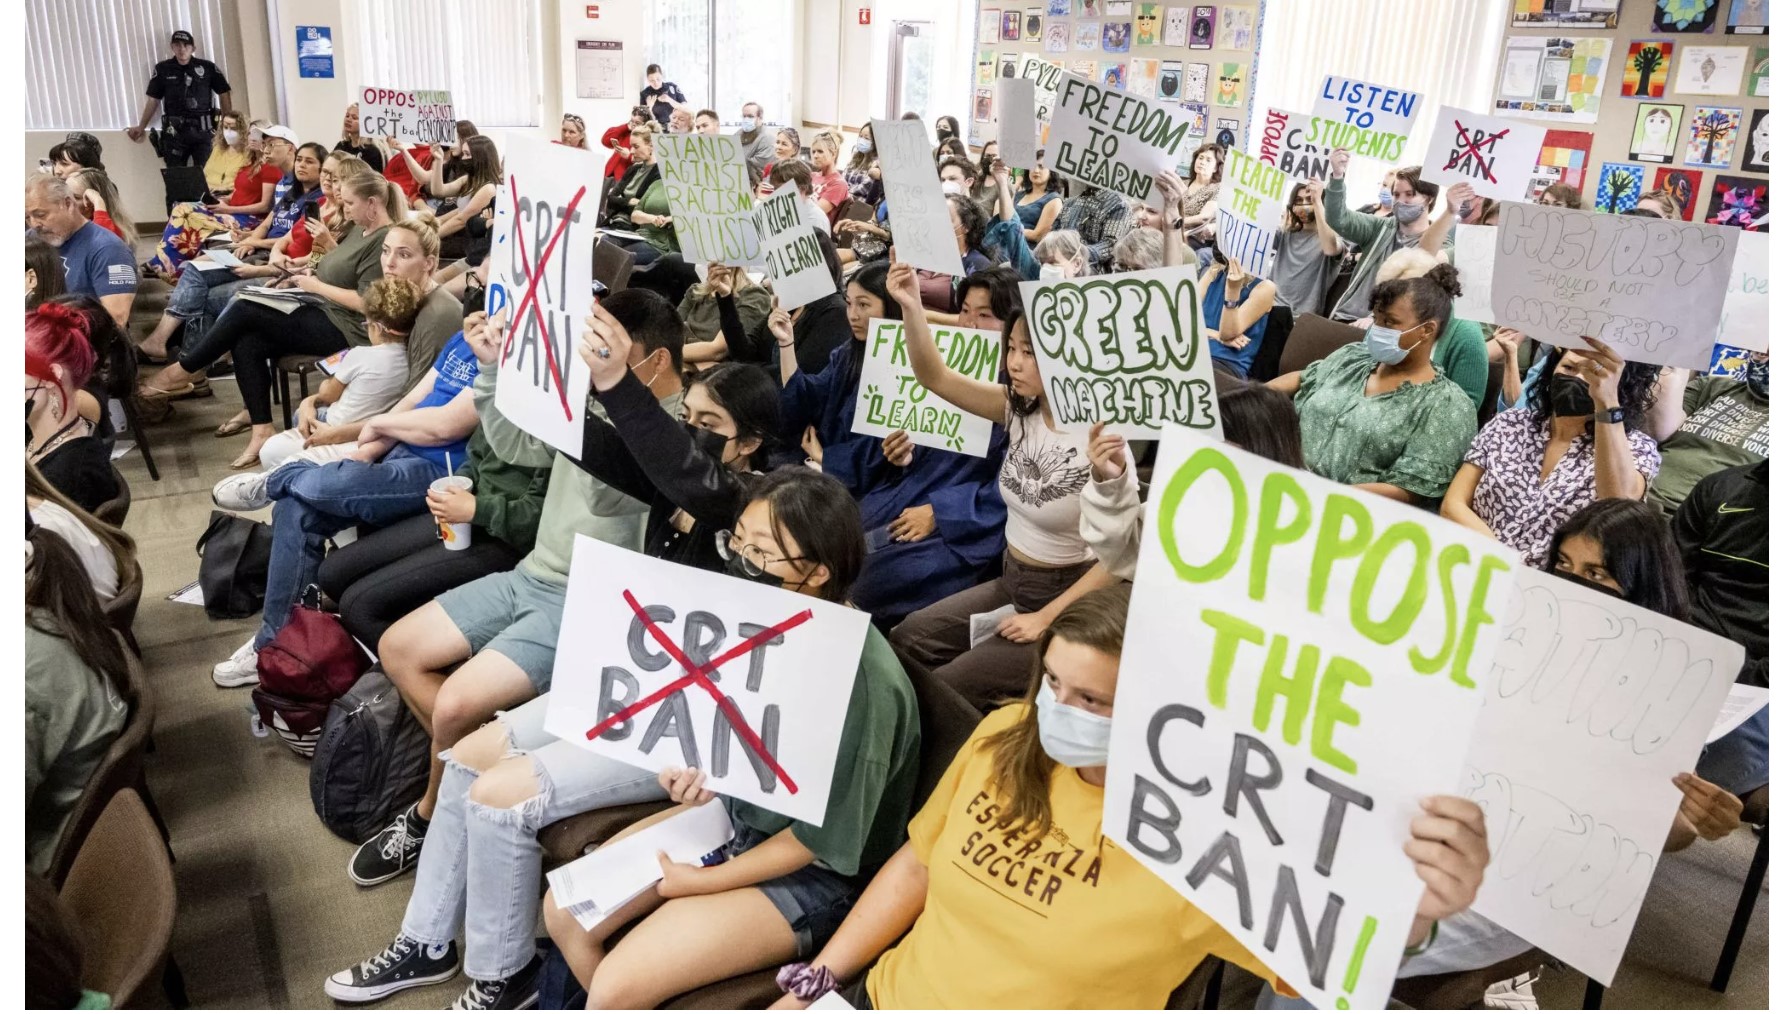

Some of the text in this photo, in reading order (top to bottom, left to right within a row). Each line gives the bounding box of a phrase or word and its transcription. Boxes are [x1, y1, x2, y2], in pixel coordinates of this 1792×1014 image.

[364, 88, 415, 108] OPPOS
[384, 108, 403, 119] the
[418, 104, 452, 119] AGAINST
[1062, 79, 1189, 155] FREEDOM
[1323, 78, 1416, 117] LISTEN
[1345, 107, 1374, 128] TO
[364, 116, 400, 138] CRT
[657, 136, 735, 162] STAND
[1088, 126, 1118, 158] TO
[1305, 117, 1407, 161] STUDENTS
[1456, 128, 1503, 153] CRT
[664, 160, 745, 190] AGINST
[1055, 141, 1152, 200] LEARN
[1231, 149, 1286, 201] TEACH
[1280, 151, 1329, 181] BAN
[1448, 149, 1495, 180] BAN
[666, 185, 753, 215] RACISM
[751, 192, 801, 242] MY RIGHT
[1232, 188, 1262, 221] THE
[512, 196, 581, 312] CRT
[672, 215, 761, 263] PYLUSD
[766, 234, 822, 281] TO LEARN
[1219, 208, 1270, 275] TRUTH
[1502, 206, 1724, 287] HISTORY
[1528, 269, 1655, 296] SHOULD NOT
[1553, 290, 1612, 308] BE A
[1032, 278, 1199, 376] GREEN
[1505, 295, 1679, 352] MYSTERY
[872, 323, 1000, 383] FREDOM
[896, 375, 929, 404] TO
[1051, 376, 1216, 430] MACHINE
[866, 394, 962, 438] LEARN
[1700, 427, 1743, 447] DIVERSE
[1157, 447, 1511, 690] OPPOSE
[627, 604, 785, 693] CRT
[1491, 582, 1713, 756] ATION
[1201, 608, 1373, 776] THE
[596, 665, 781, 794] BAN
[1146, 703, 1374, 878] CRT
[966, 790, 1102, 888] ESPERNZA
[961, 831, 1062, 906] SOCCER
[1126, 773, 1378, 1010] BAN!
